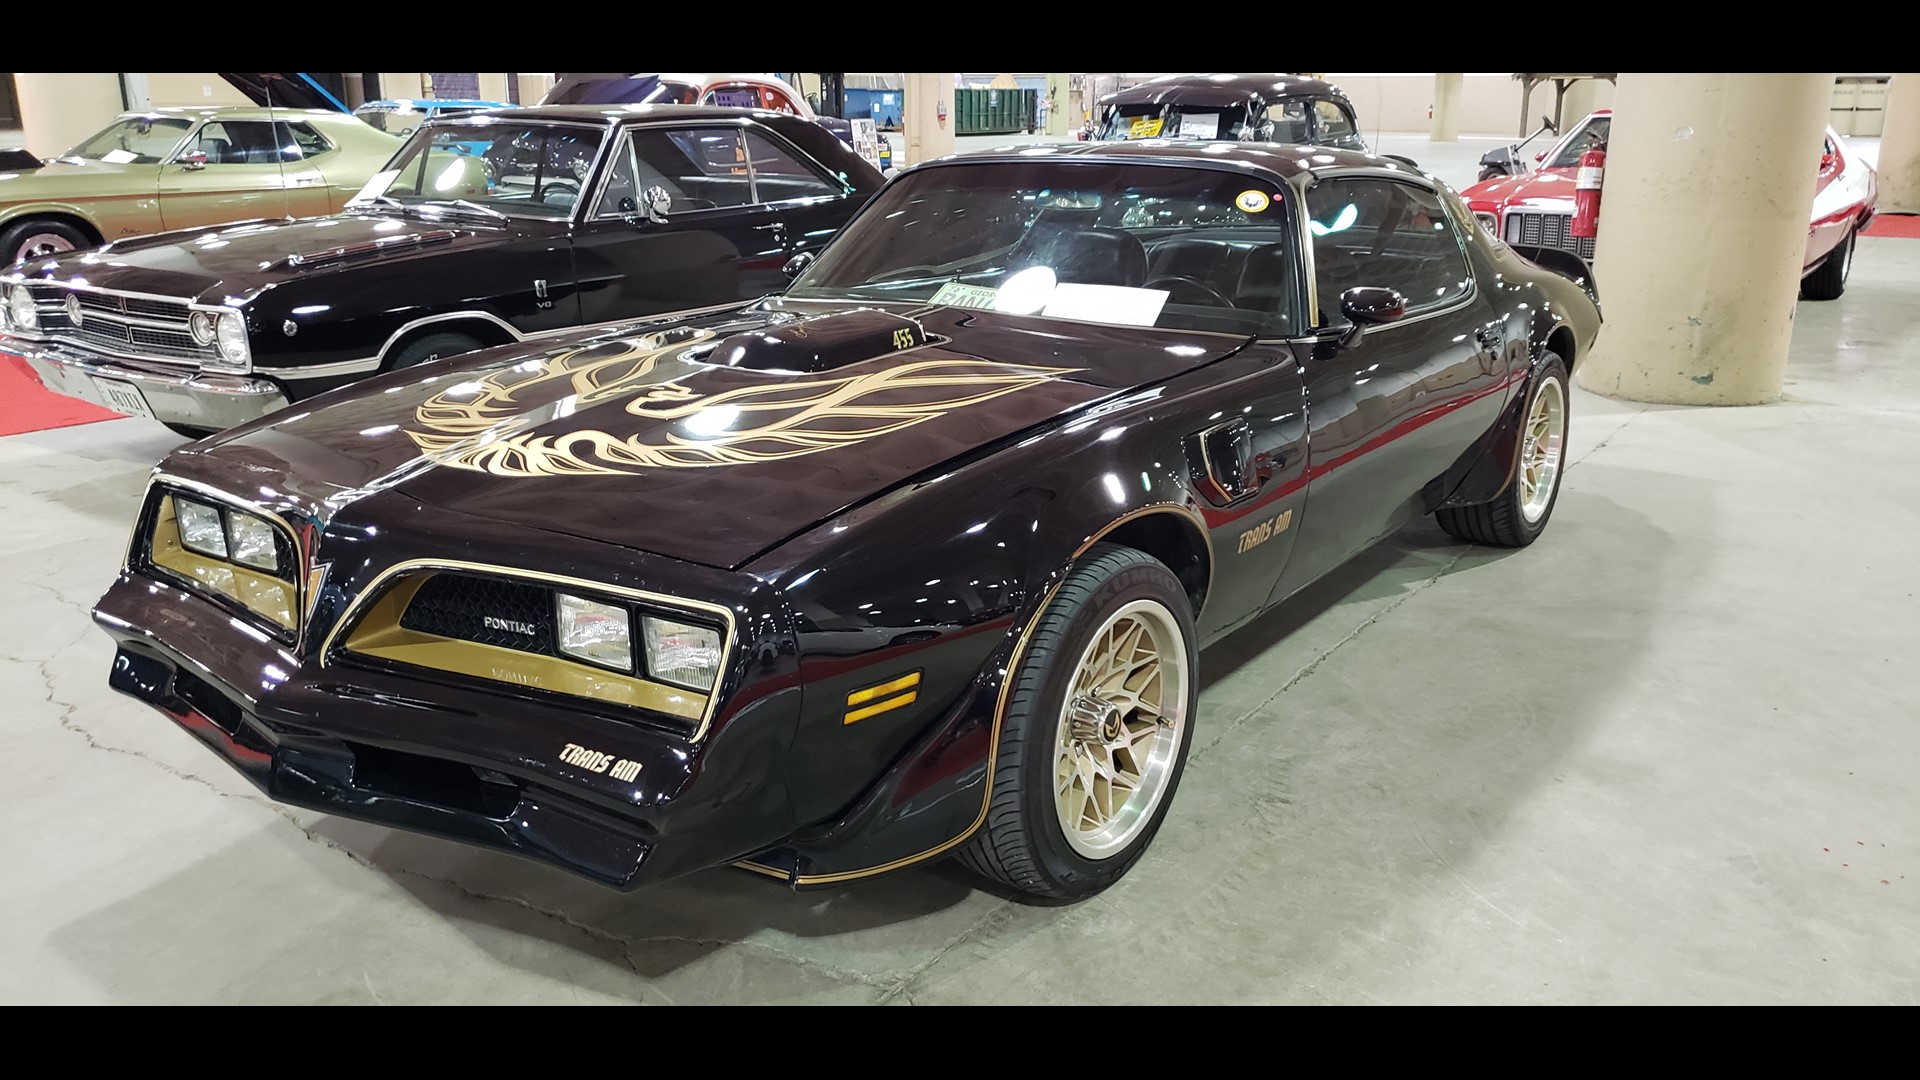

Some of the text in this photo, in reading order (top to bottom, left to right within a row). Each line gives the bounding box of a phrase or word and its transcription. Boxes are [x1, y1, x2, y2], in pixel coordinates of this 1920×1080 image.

[970, 289, 998, 299] GEOR
[893, 328, 914, 349] 455
[1237, 509, 1292, 554] TRANS AM
[1094, 567, 1177, 608] KUMHO
[484, 616, 535, 635] PONTIAC
[559, 743, 643, 783] TRANS AM
